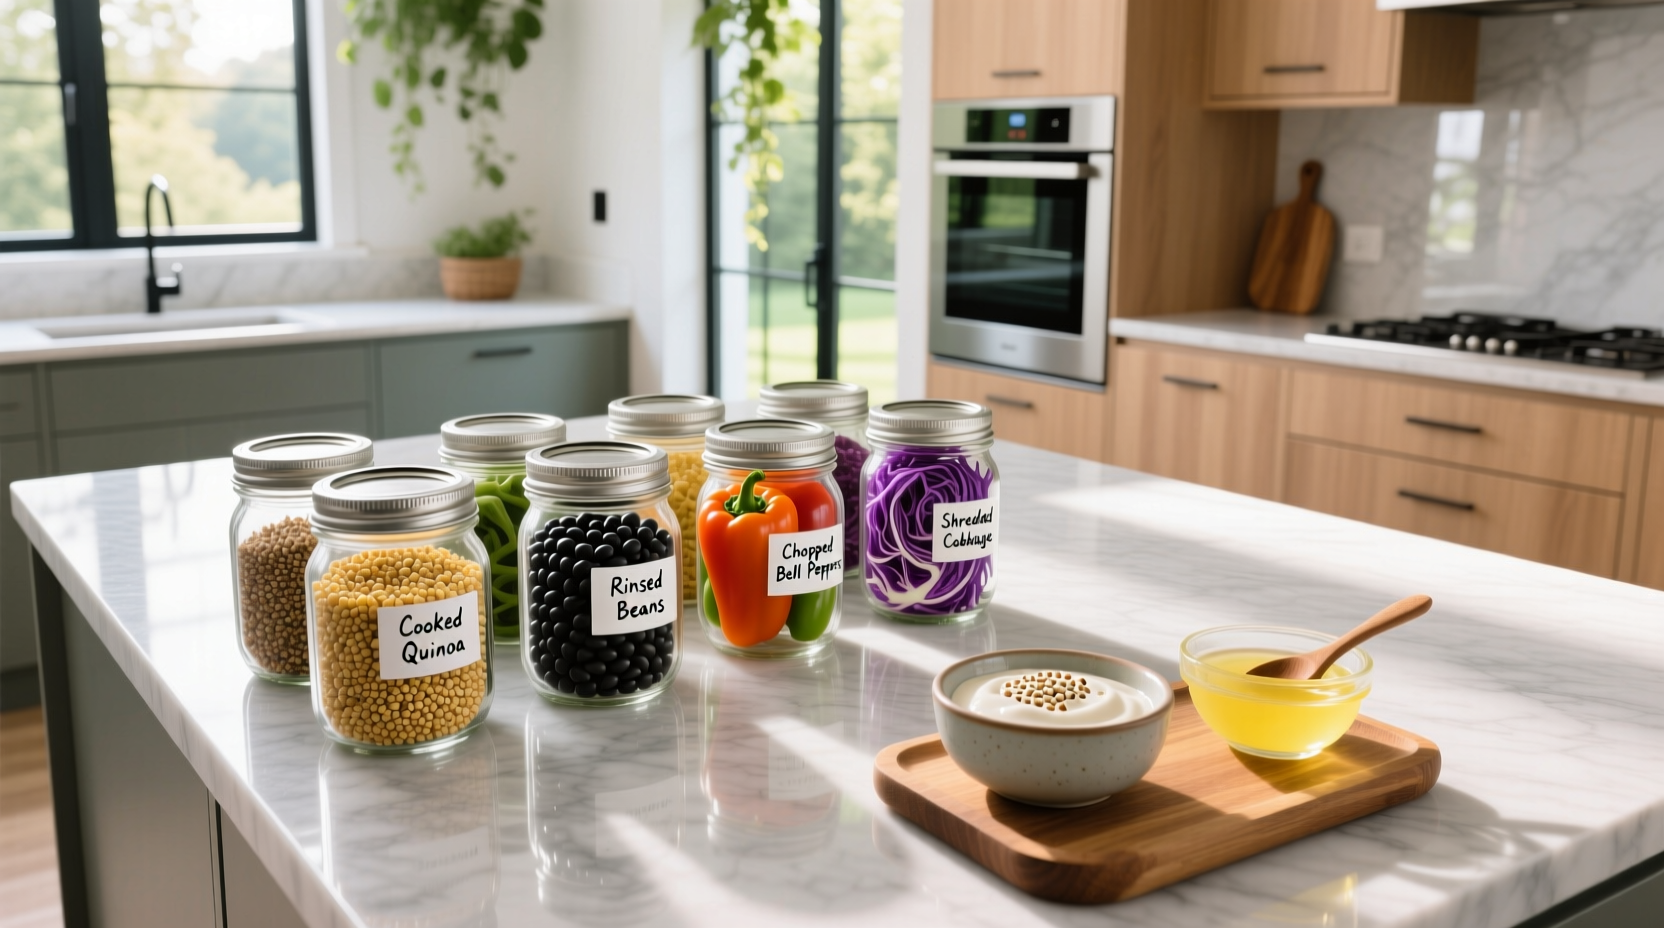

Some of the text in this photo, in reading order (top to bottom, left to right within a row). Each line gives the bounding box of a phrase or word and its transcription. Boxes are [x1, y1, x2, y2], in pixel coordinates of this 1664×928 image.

[782, 535, 833, 561] Chopped
[611, 569, 662, 597] Rinsed
[776, 563, 801, 582] Bell
[399, 606, 462, 637] Cooked
[617, 599, 664, 620] Beans
[402, 640, 465, 665] Quinoa
